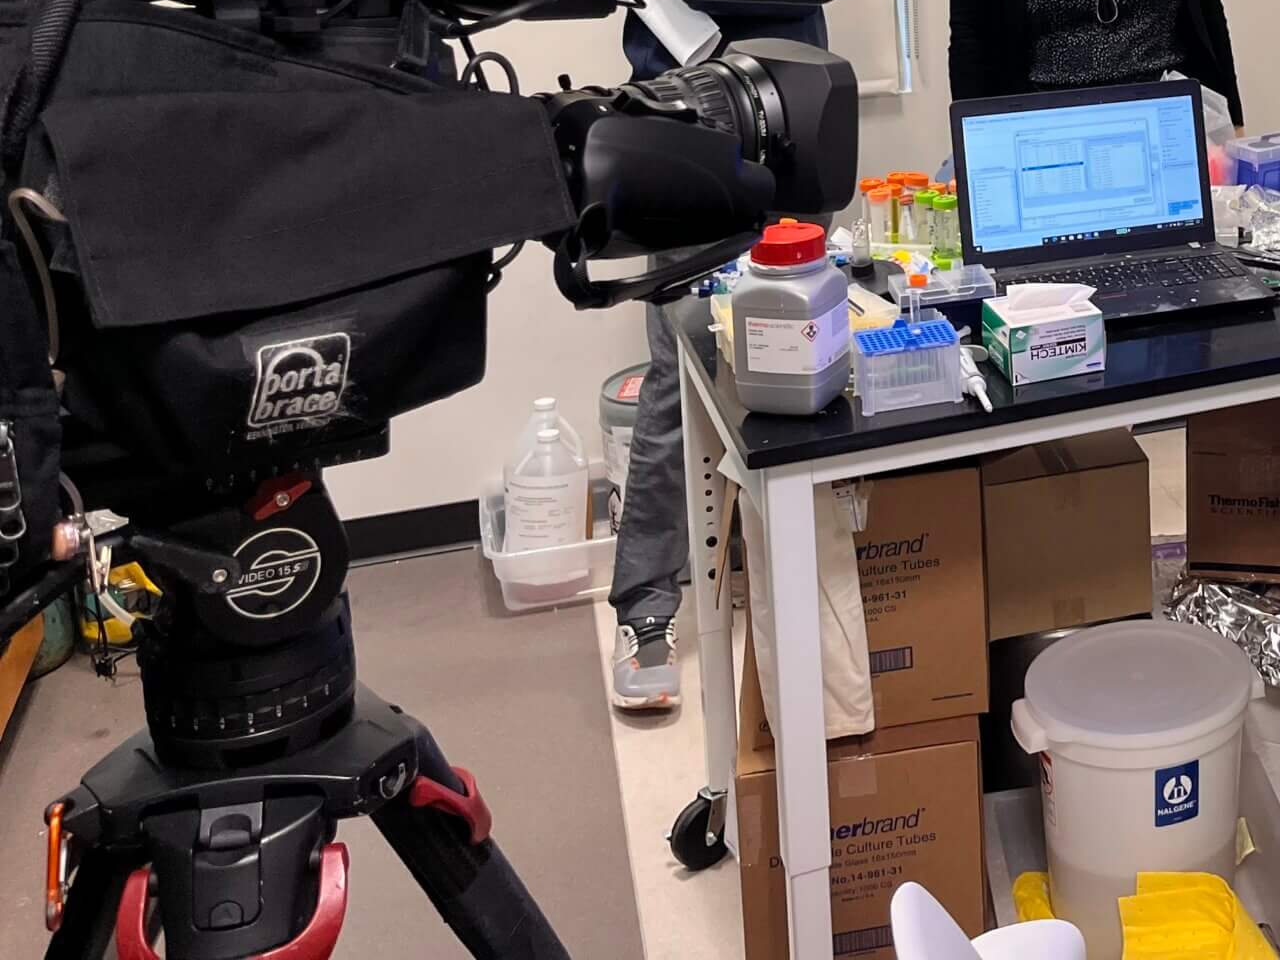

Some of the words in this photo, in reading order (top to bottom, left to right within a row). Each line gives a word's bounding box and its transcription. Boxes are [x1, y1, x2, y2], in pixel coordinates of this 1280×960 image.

[1030, 343, 1087, 361] KIMTECH
[262, 361, 342, 400] porta
[255, 391, 338, 421] brace
[856, 532, 924, 560] rbrand
[278, 565, 291, 577] 15
[859, 563, 897, 577] ulture
[902, 558, 941, 571] Tubes
[1157, 802, 1195, 816] NALGENE
[831, 808, 921, 841] erbrand
[846, 840, 893, 856] Culture
[896, 831, 937, 848] Tubes
